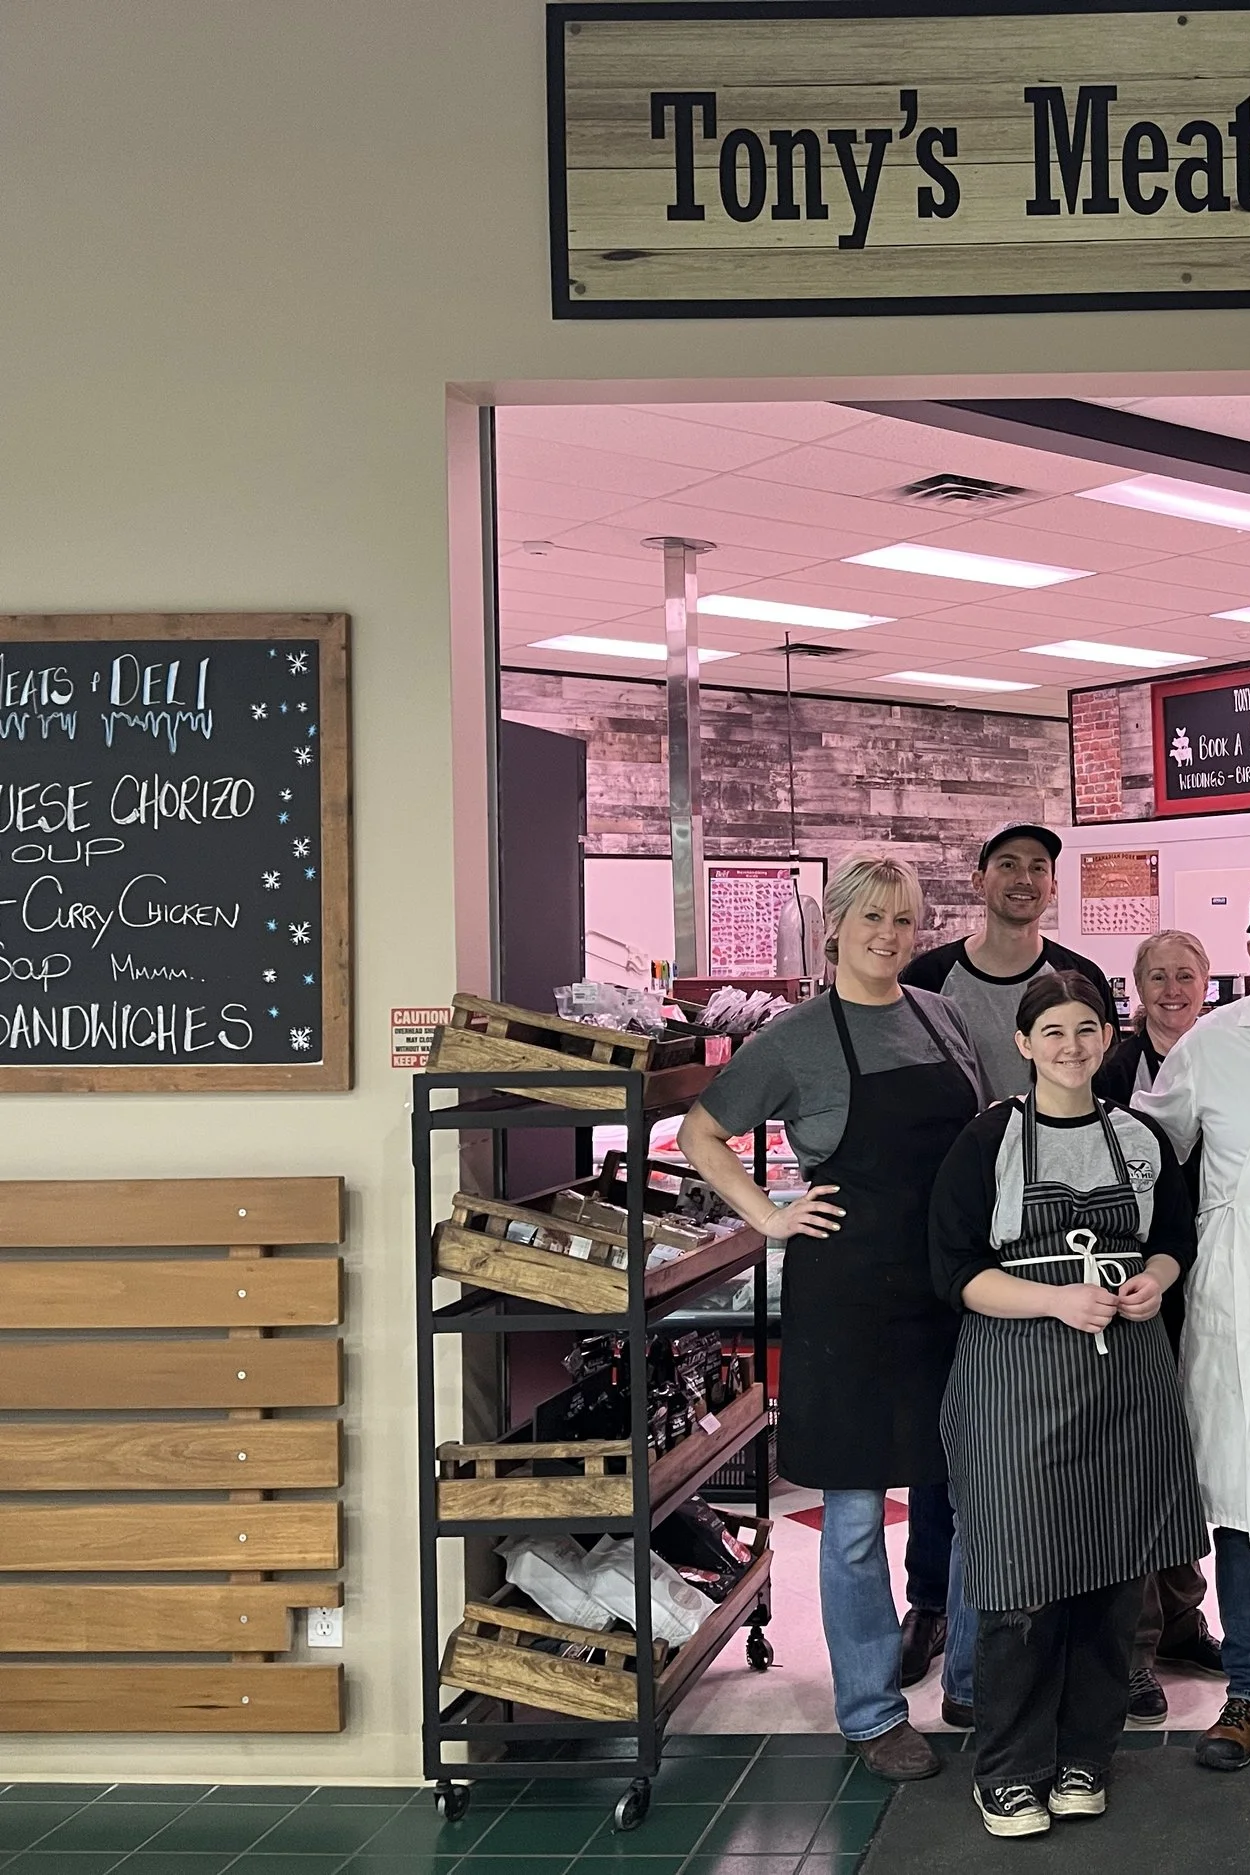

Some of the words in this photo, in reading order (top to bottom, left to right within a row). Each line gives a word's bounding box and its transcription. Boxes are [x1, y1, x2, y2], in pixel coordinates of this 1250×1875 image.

[650, 86, 959, 250] Tony's
[0, 653, 74, 714] EATS
[1199, 734, 1230, 761] BOOK
[1234, 733, 1244, 756] A
[0, 781, 93, 833] UESE
[111, 773, 255, 830] CHORIZO
[11, 838, 125, 867] OUP
[393, 1010, 449, 1025] CAUTION
[393, 1055, 418, 1067] KEEP
